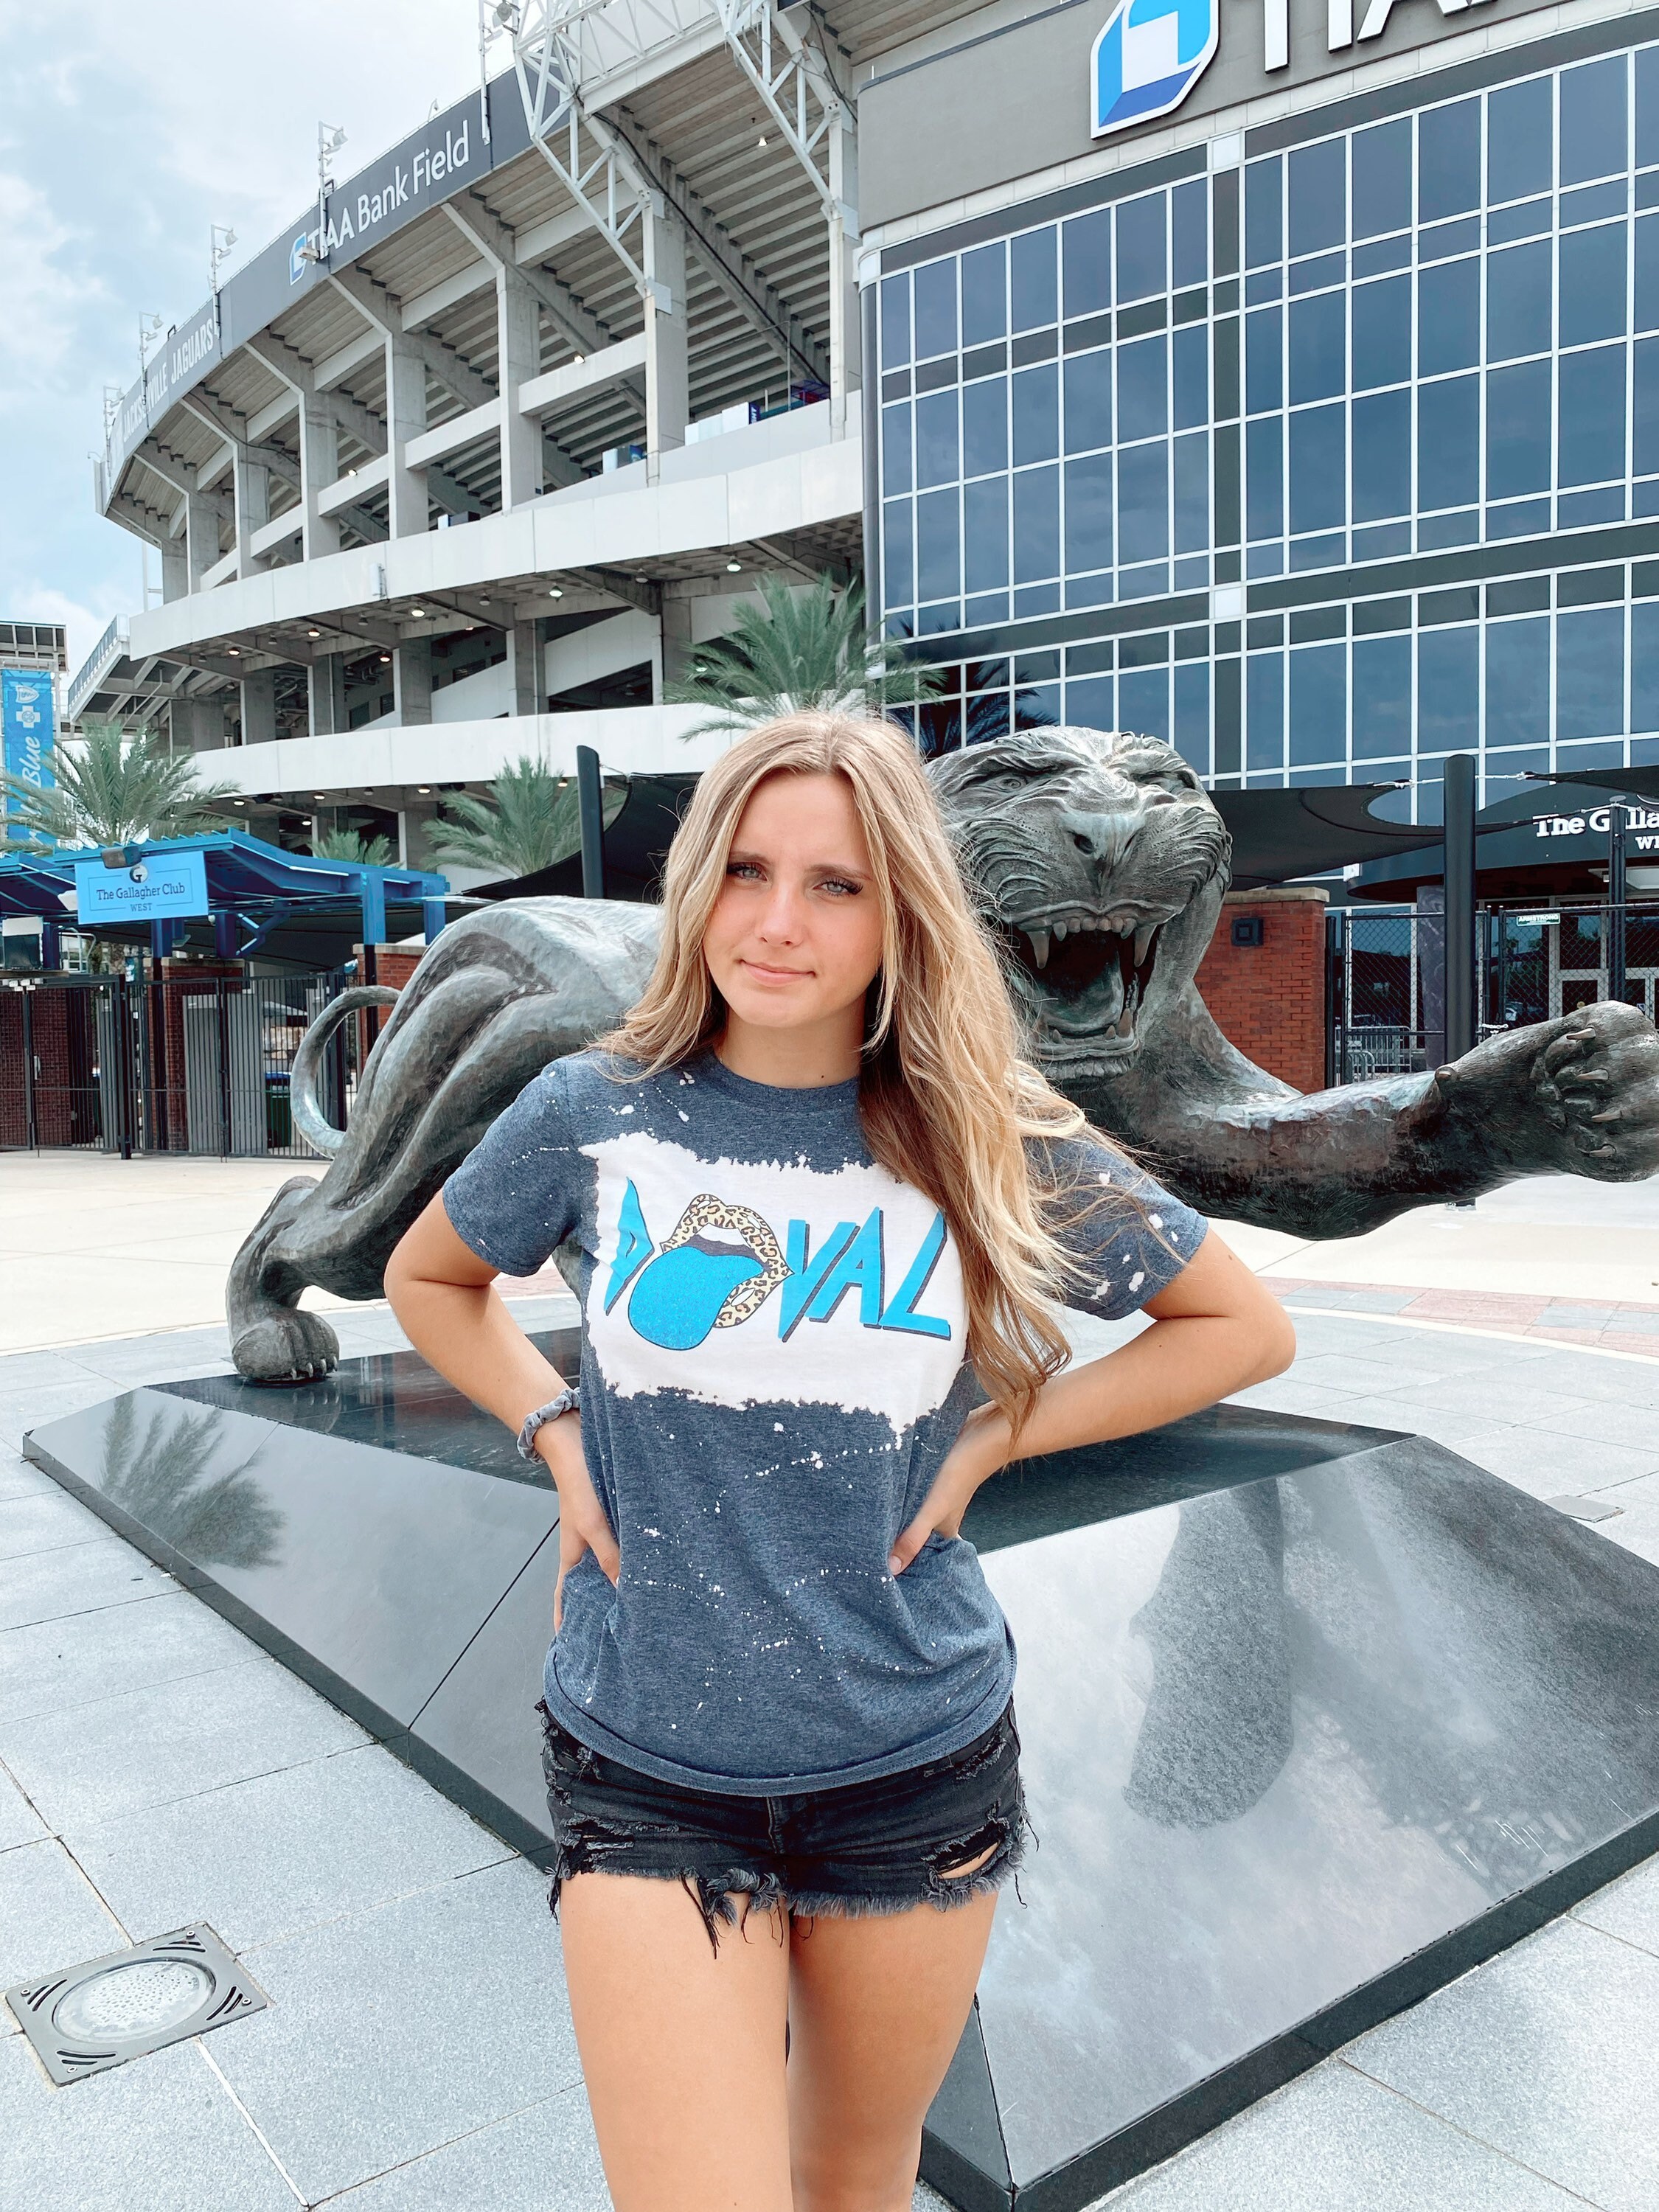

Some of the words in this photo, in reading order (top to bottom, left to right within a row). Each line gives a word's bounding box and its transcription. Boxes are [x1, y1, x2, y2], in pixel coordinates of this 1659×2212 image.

[358, 165, 408, 233] Bank
[413, 119, 469, 195] Field
[123, 362, 168, 442] JACKSNVILLE
[171, 318, 214, 384] JAGUARS
[19, 736, 41, 788] Blue
[1533, 813, 1585, 837] The
[97, 889, 114, 900] The
[116, 886, 161, 900] Gallagher
[162, 883, 185, 895] Club
[131, 903, 152, 911] WEST
